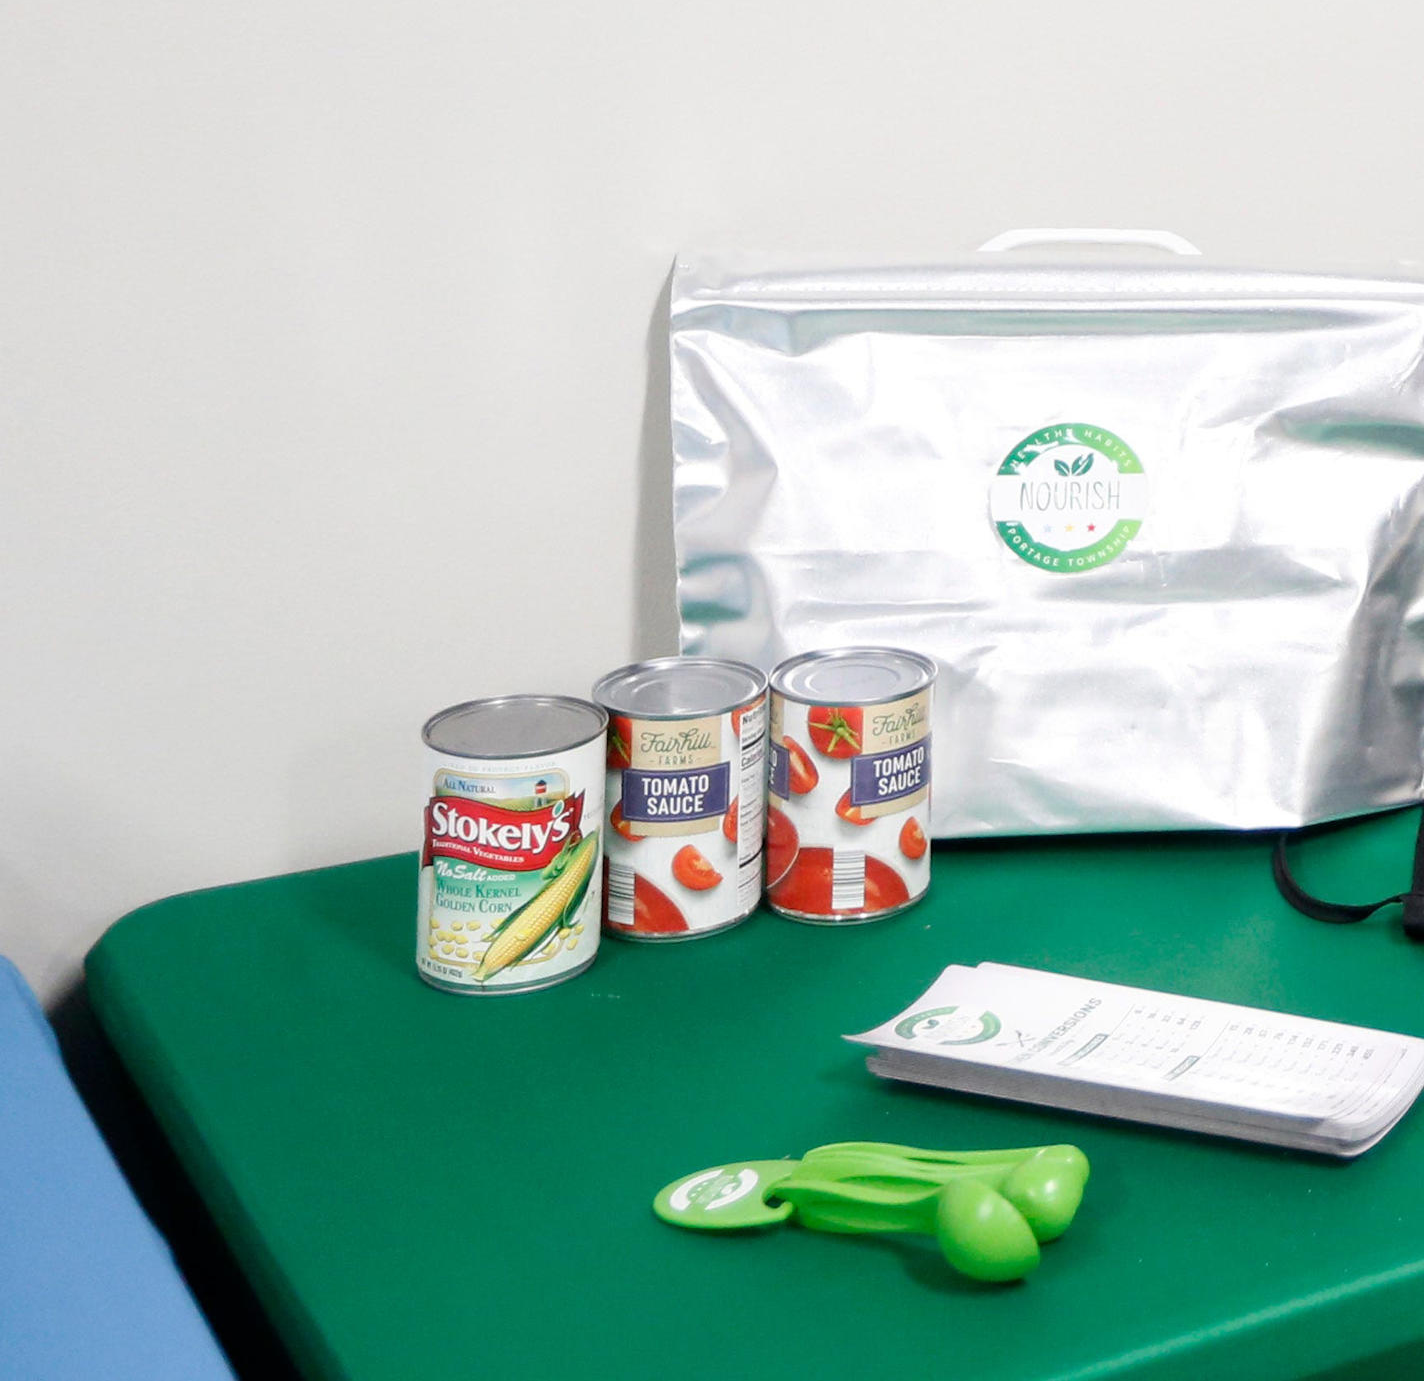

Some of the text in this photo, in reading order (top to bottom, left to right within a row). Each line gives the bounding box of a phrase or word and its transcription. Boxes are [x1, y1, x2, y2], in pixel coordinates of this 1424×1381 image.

[1009, 428, 1132, 470] HELTH HABITS
[1019, 481, 1121, 512] NOURISH
[1007, 525, 1130, 567] PORTAGE TOWNSHIP
[640, 727, 711, 754] Fairhill
[658, 754, 693, 765] FARMS
[873, 746, 924, 778] TOMATO
[641, 774, 710, 796] TOMATO
[878, 766, 921, 796] SAUCE
[647, 794, 704, 815] SAUCE
[431, 800, 572, 855] Stokely's
[453, 865, 488, 881] Salt
[479, 899, 512, 914] CORN
